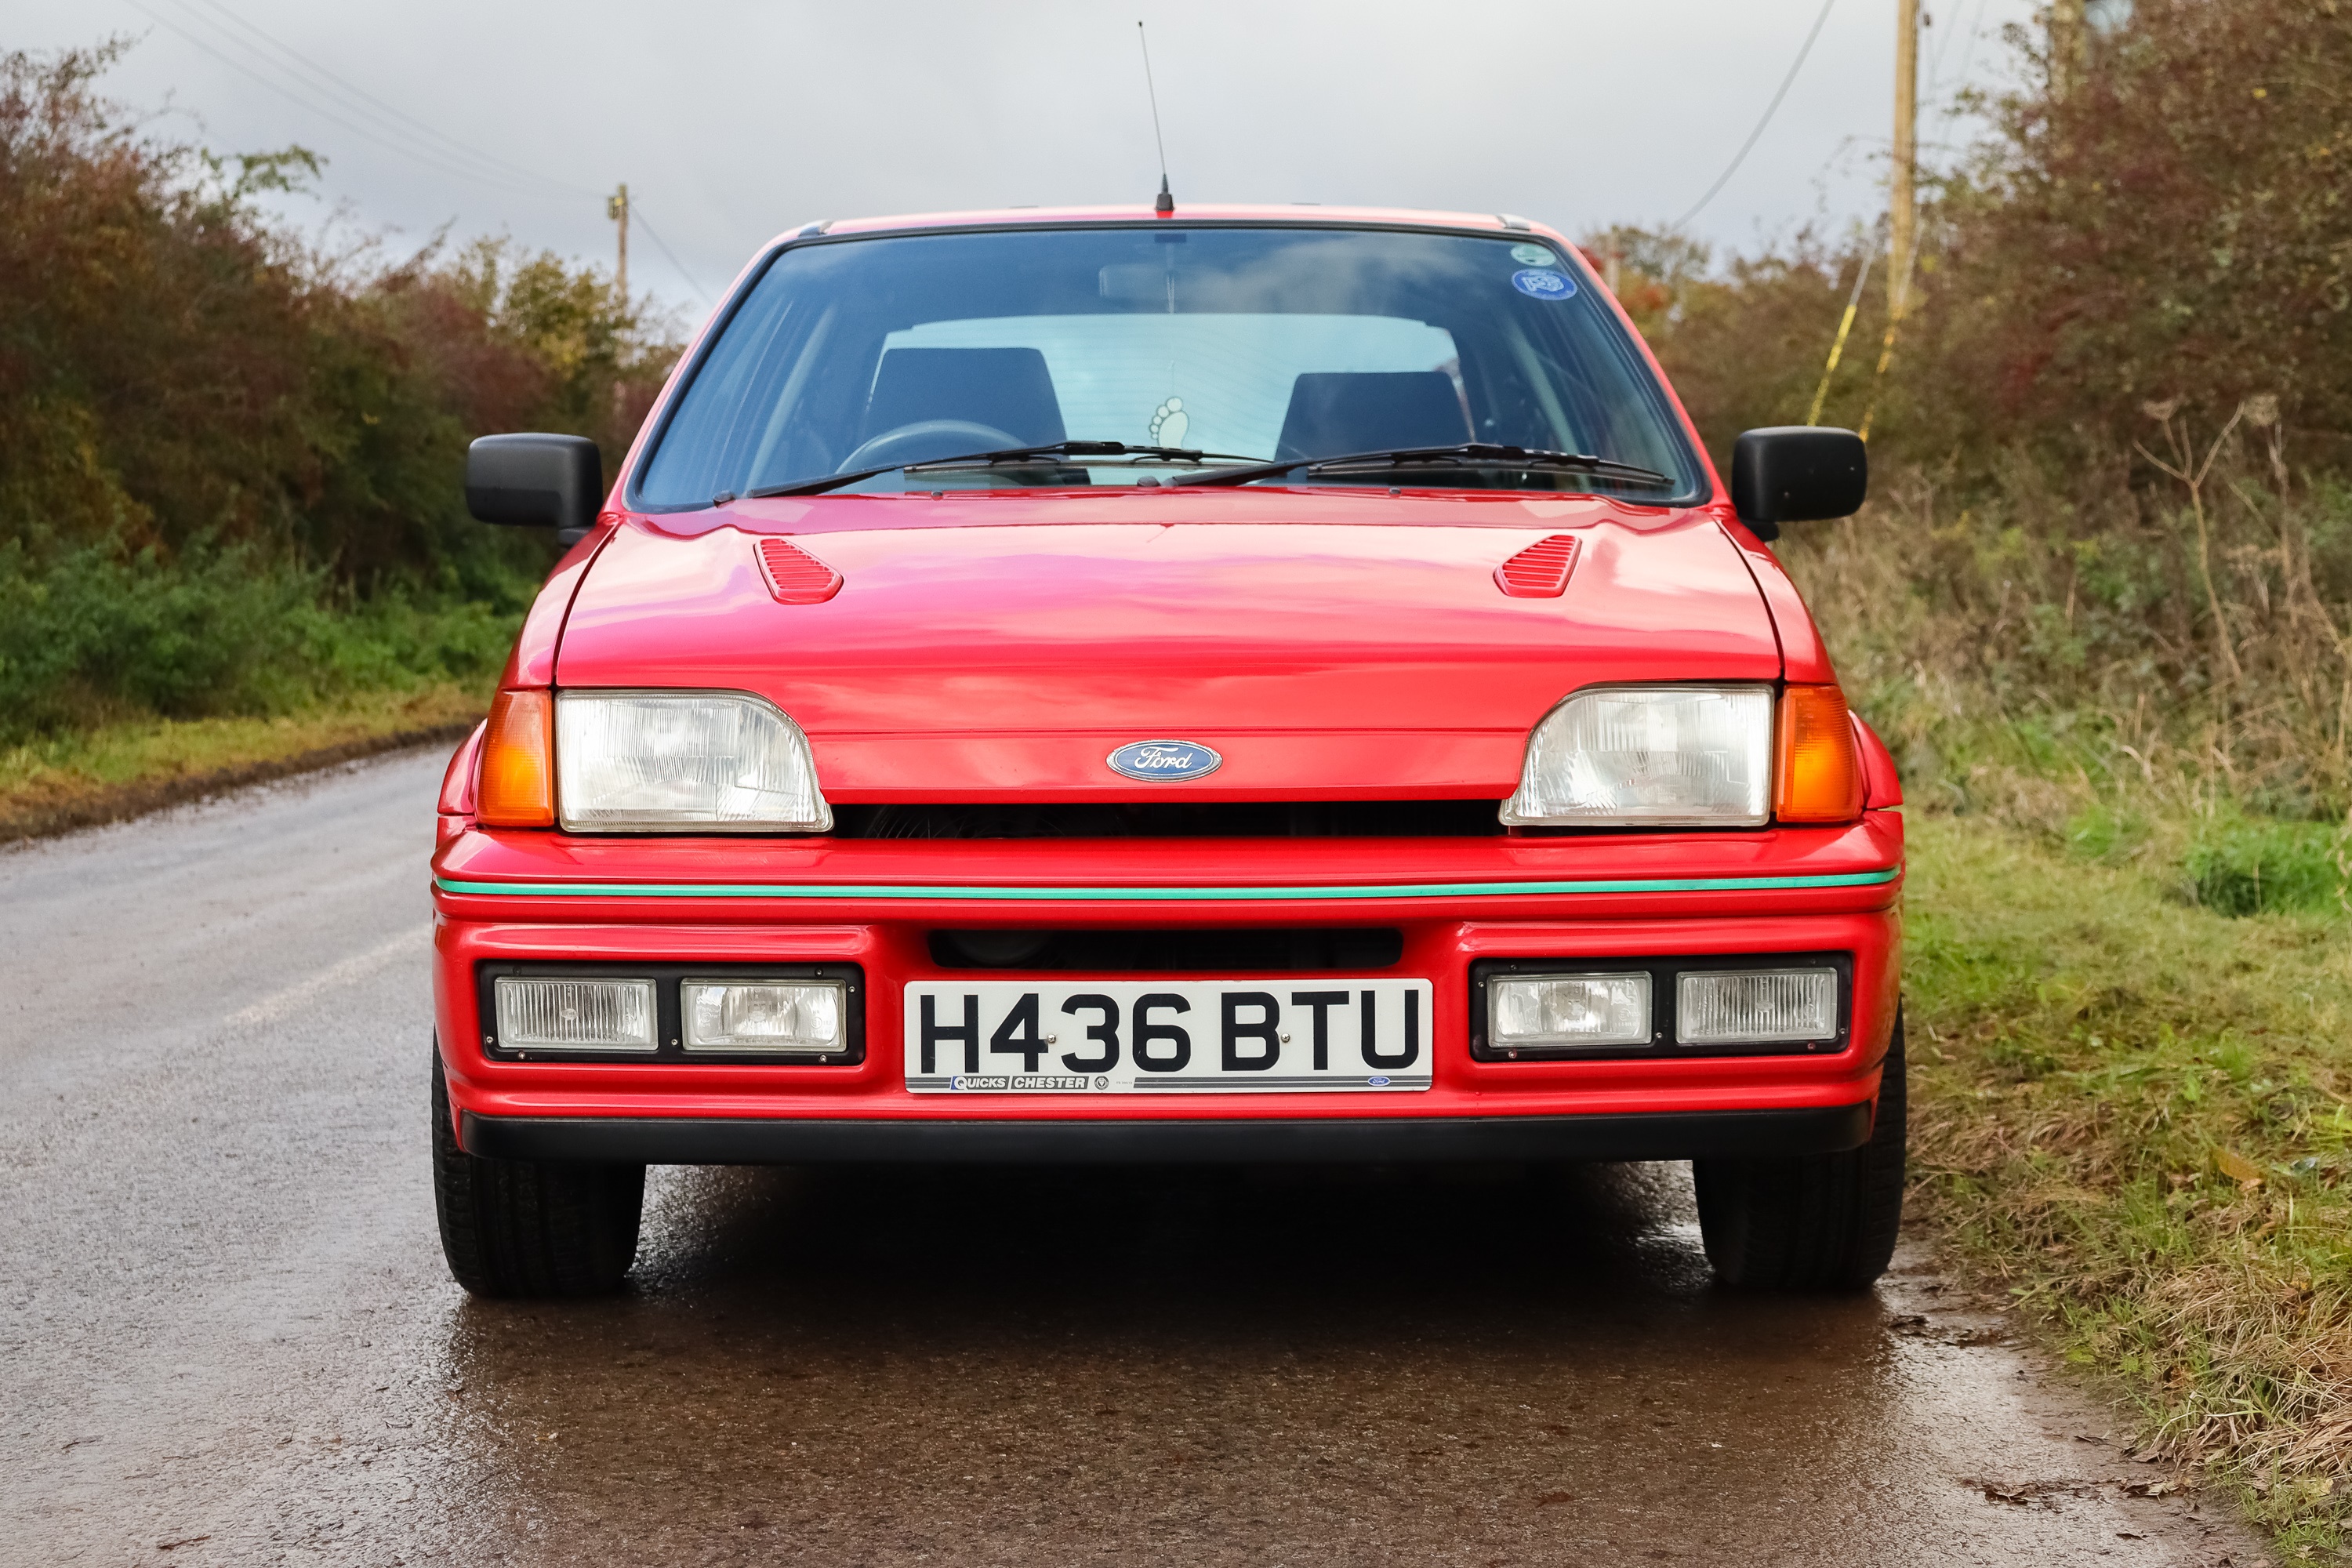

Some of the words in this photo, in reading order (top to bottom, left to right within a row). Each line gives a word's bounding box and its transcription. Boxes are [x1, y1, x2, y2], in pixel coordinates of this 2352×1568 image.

[1134, 746, 1193, 768] Ford
[920, 993, 1191, 1074] H436
[1221, 989, 1419, 1072] BTU
[954, 1076, 1006, 1091] QUICKS
[1014, 1077, 1086, 1088] CHESTER
